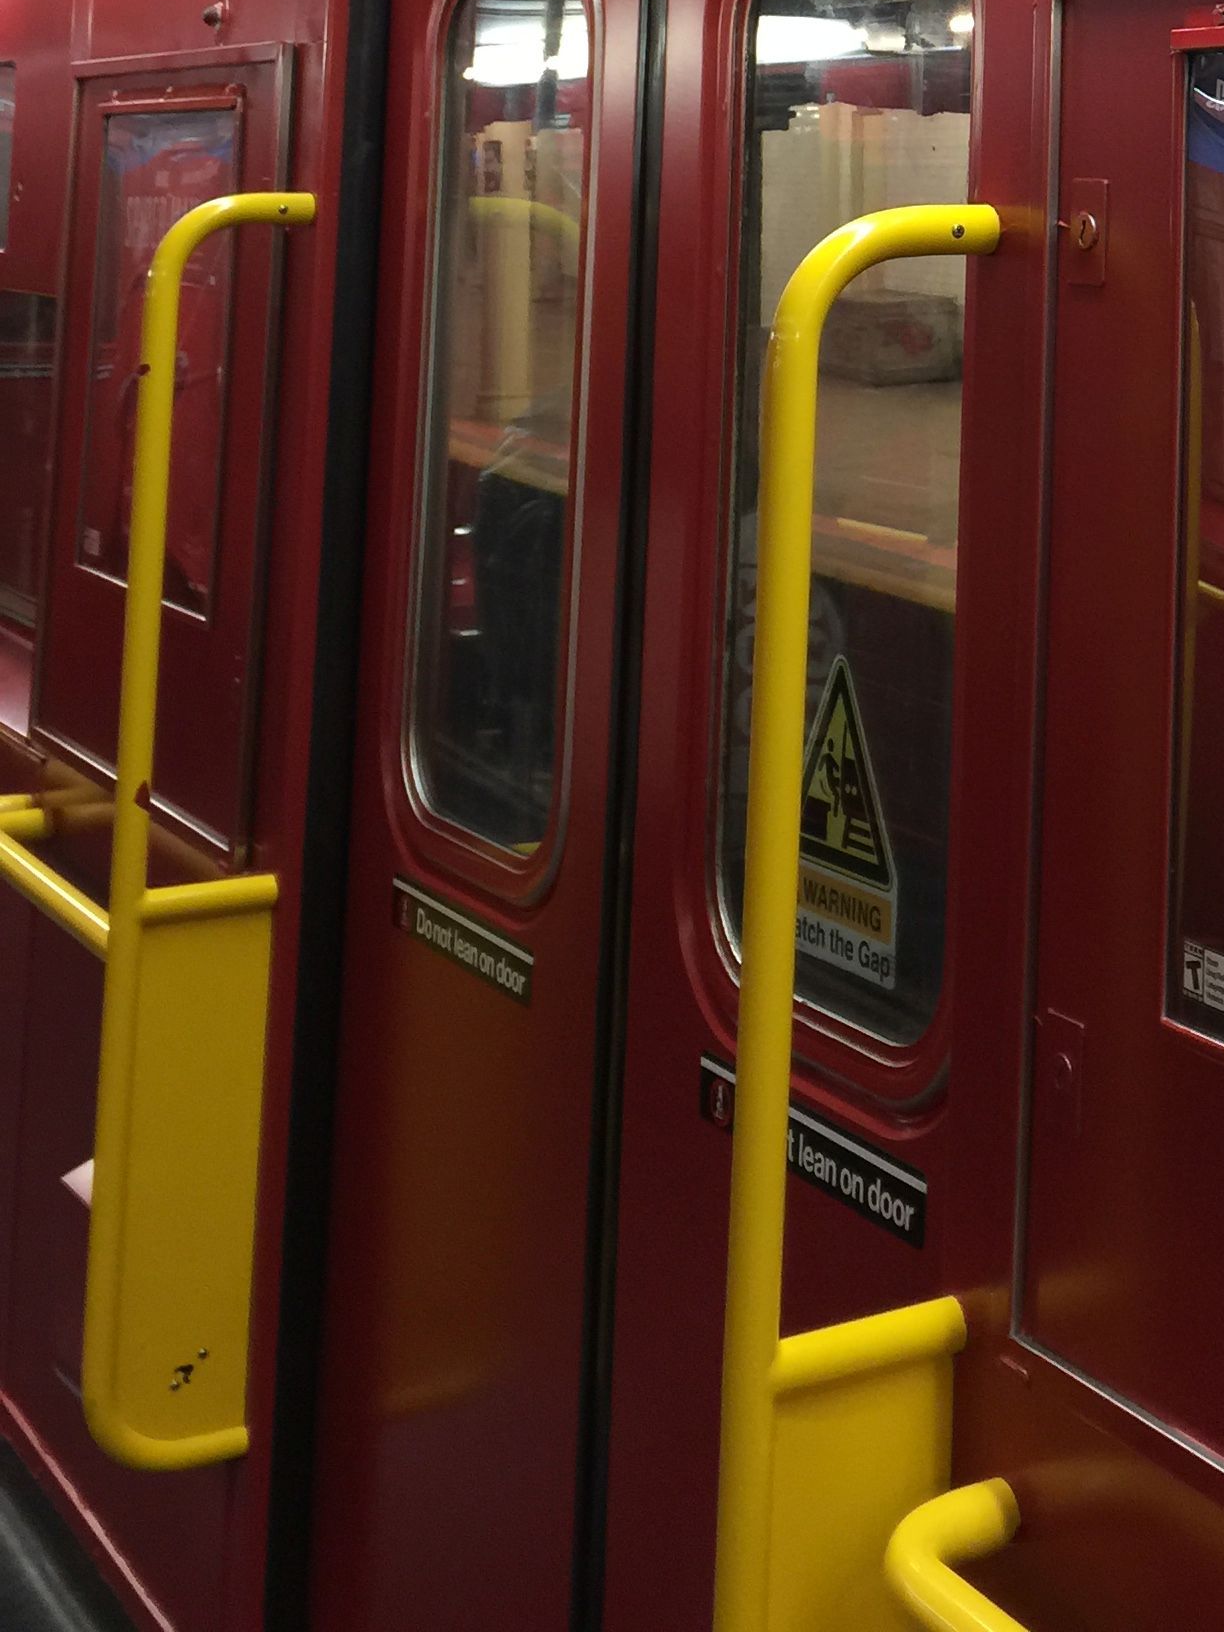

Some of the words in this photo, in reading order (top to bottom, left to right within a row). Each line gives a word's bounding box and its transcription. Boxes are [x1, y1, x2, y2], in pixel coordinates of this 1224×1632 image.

[803, 877, 881, 933] WARNING
[416, 908, 432, 940] Do
[433, 925, 452, 951] not
[454, 930, 478, 968] lean
[479, 952, 495, 978] on
[496, 958, 526, 995] door
[796, 916, 825, 947] atch
[830, 929, 853, 960] the
[858, 940, 890, 982] Gap
[1186, 960, 1201, 990] T
[799, 1133, 836, 1188] lean
[840, 1168, 864, 1204] on
[867, 1179, 914, 1231] door
